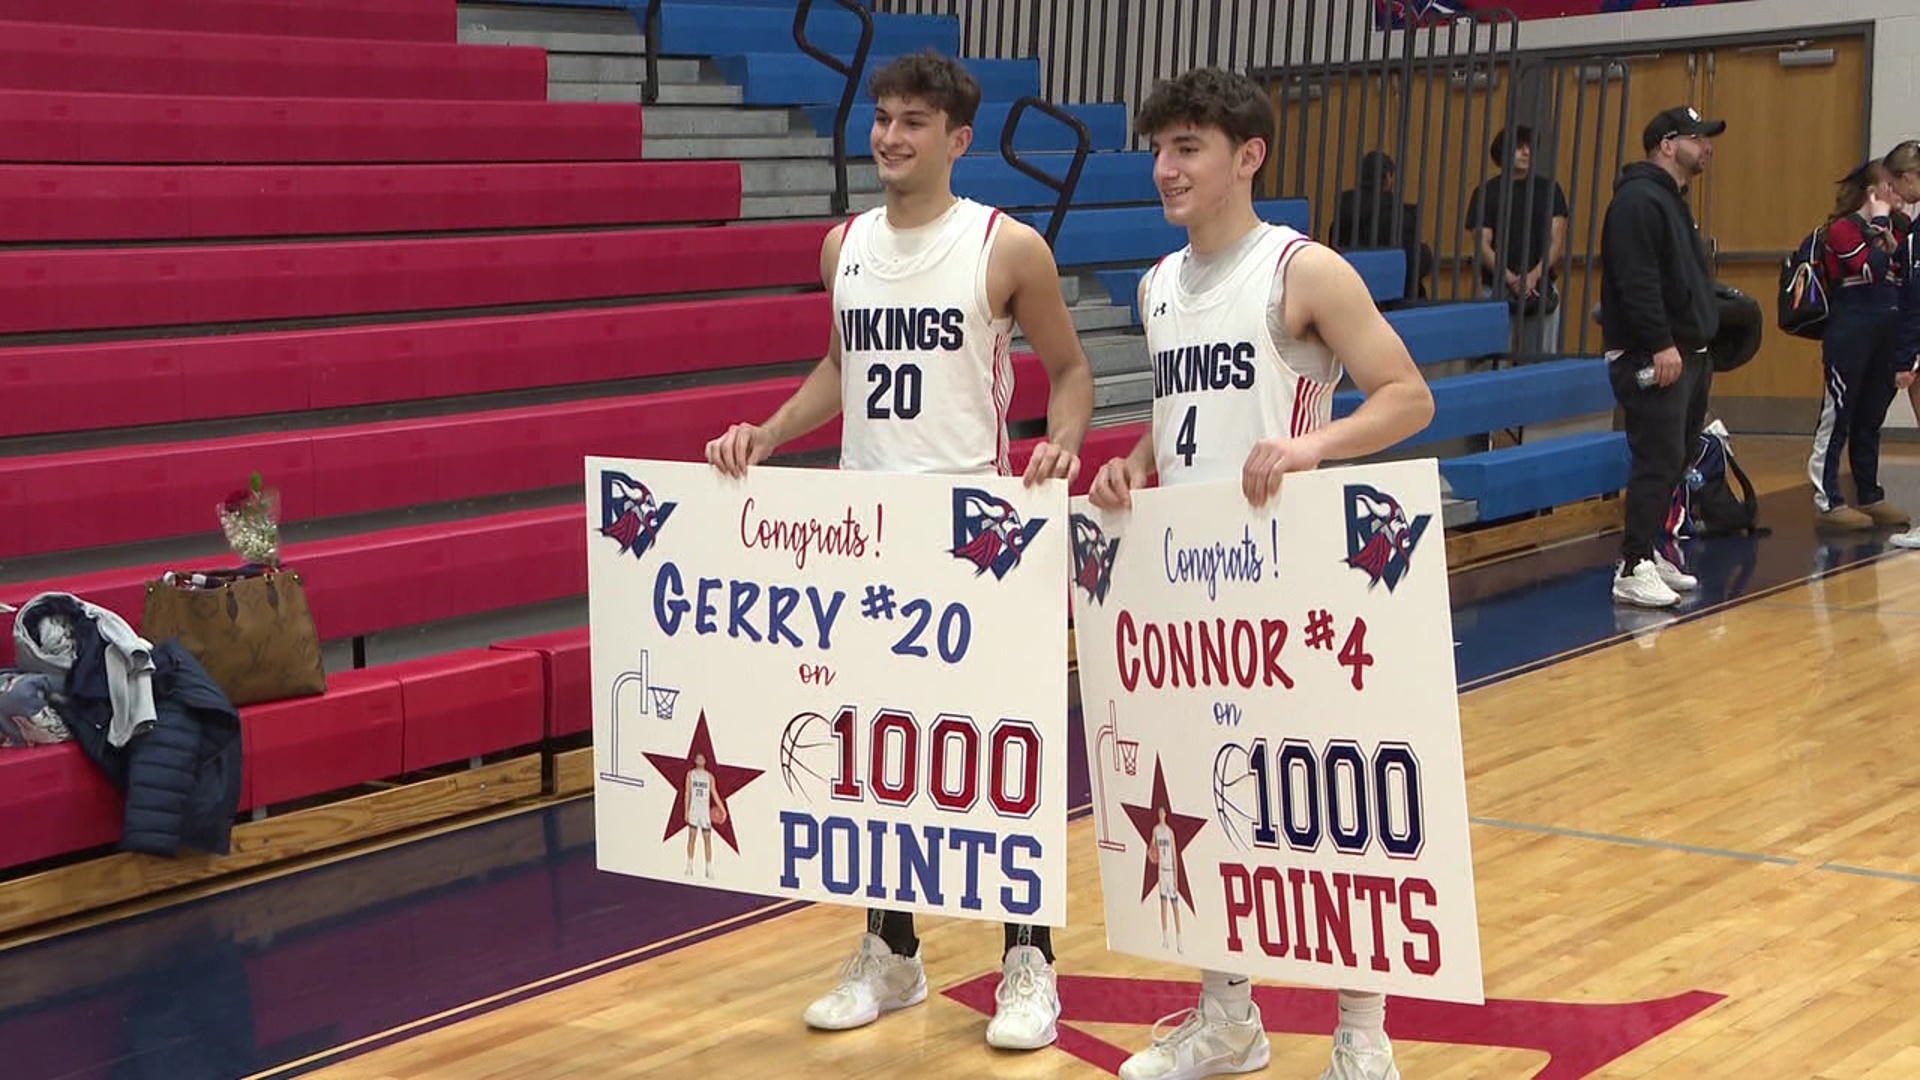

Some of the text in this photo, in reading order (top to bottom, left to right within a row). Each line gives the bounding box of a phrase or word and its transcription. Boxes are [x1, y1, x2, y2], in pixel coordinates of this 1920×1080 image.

[841, 307, 964, 352] VIKINGS
[867, 363, 922, 420] 20
[1153, 341, 1255, 399] VIKINGS
[1176, 405, 1197, 467] 4
[653, 561, 972, 664] GERRY #20
[799, 663, 836, 686] on
[1116, 609, 1374, 692] CONNOR #4
[1213, 701, 1242, 726] on
[831, 705, 1043, 820] 1000
[1248, 738, 1426, 860] 1000
[779, 810, 1043, 916] POINTS
[1219, 863, 1442, 976] POINTS
